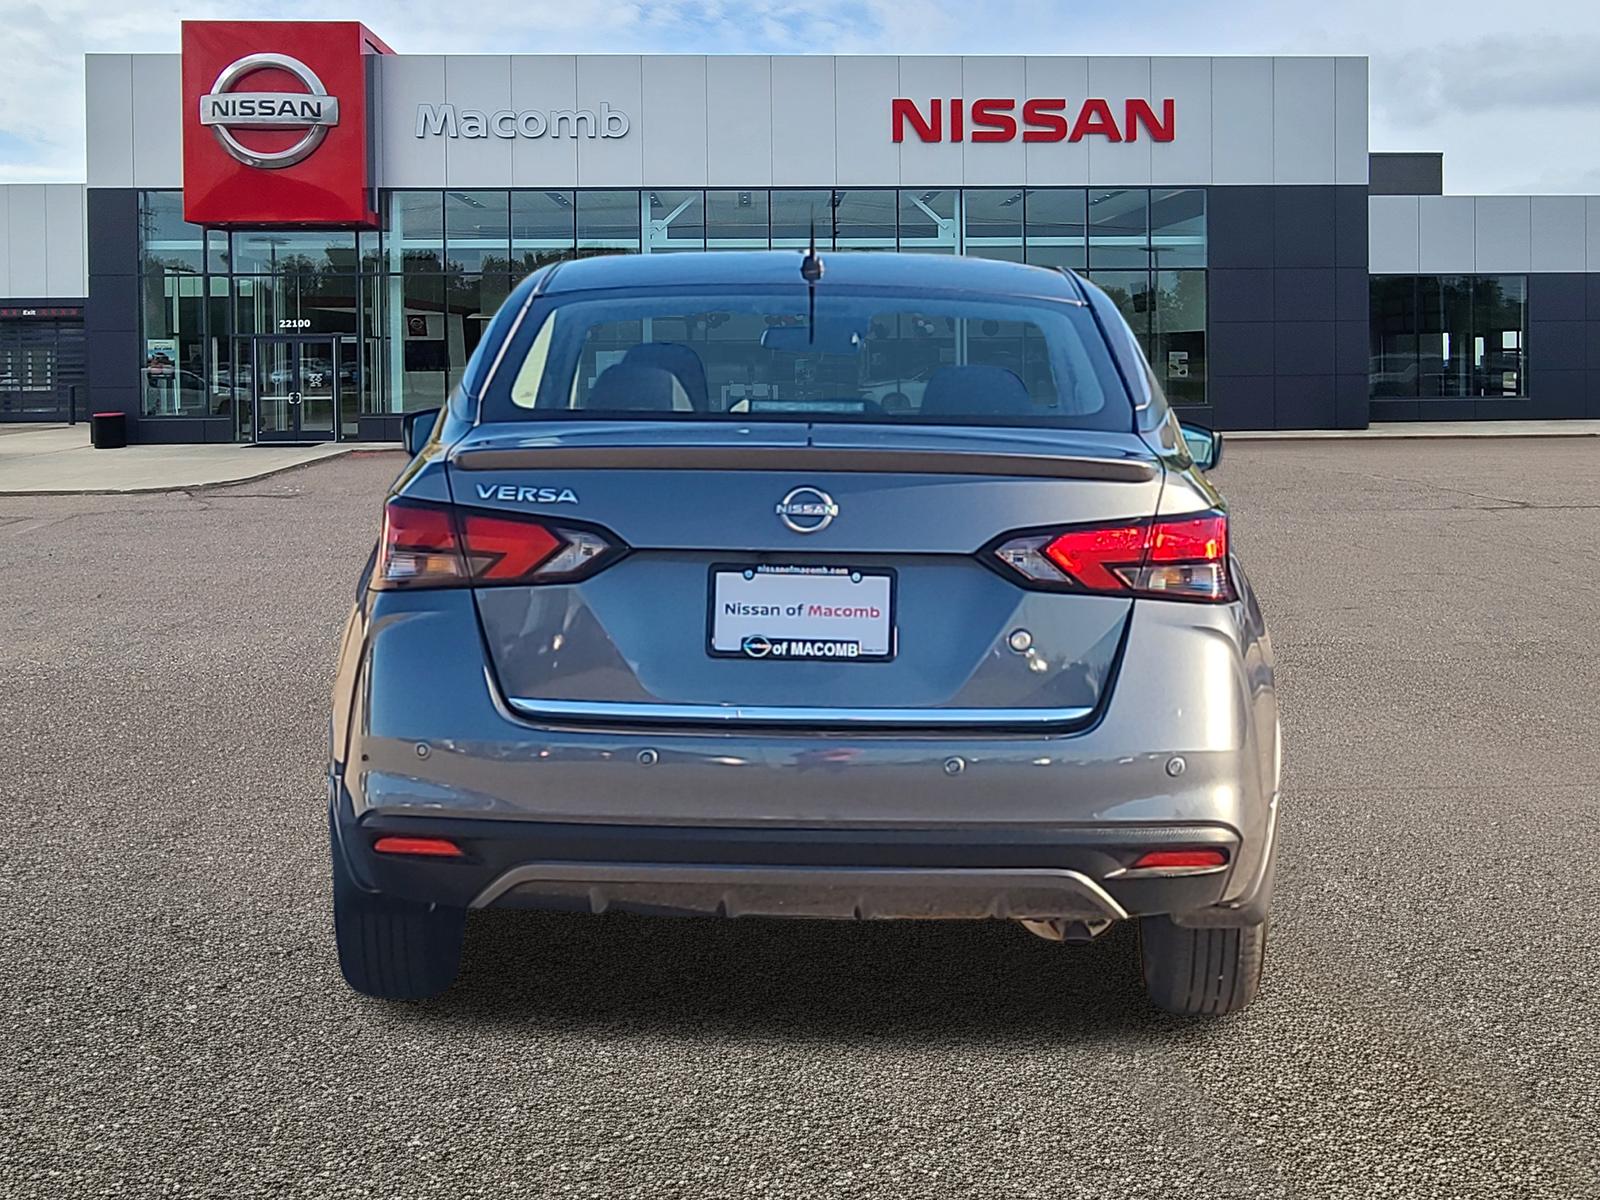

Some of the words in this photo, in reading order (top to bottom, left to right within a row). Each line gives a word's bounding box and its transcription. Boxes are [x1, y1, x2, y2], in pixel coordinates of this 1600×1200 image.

[212, 100, 322, 118] NISSAN
[415, 102, 630, 138] Macomb
[892, 98, 1176, 143] NISSAN
[279, 319, 311, 328] 22100
[476, 483, 578, 504] VERSA
[775, 503, 837, 516] NISSAN
[724, 602, 781, 617] Nissan
[786, 603, 804, 617] of
[807, 605, 881, 619] Macomb
[772, 641, 789, 656] of
[790, 641, 859, 658] MACOMB
